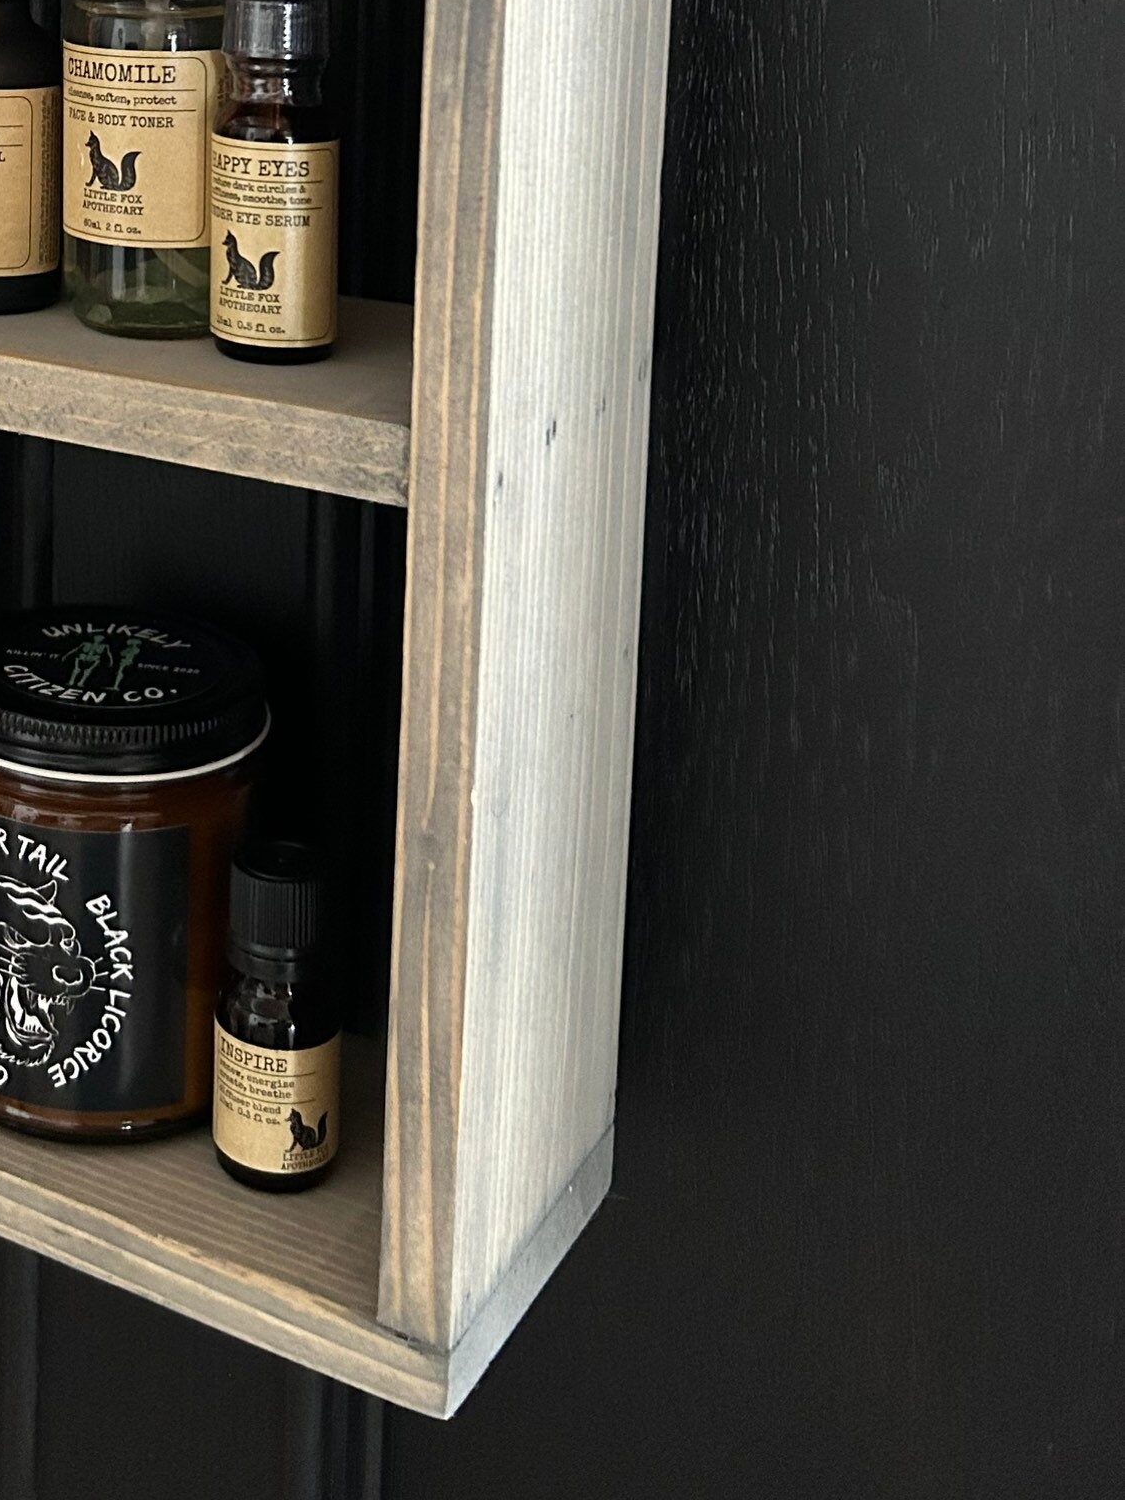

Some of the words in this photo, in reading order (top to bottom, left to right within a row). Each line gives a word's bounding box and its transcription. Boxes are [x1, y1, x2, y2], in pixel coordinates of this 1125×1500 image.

[68, 57, 176, 84] CHAMOMILE
[95, 92, 131, 105] soften,
[133, 95, 178, 106] protect
[69, 106, 86, 122] FACE
[88, 111, 95, 123] &
[97, 112, 127, 127] BODY
[129, 115, 175, 128] TONER
[258, 160, 310, 177] EYES
[83, 187, 117, 202] LITTLE
[120, 194, 143, 204] FOX
[232, 180, 255, 192] dark
[256, 185, 297, 194] circles
[299, 185, 307, 194] &
[82, 199, 145, 216] APOTHECARY
[105, 222, 112, 231] 2
[236, 211, 262, 226] EYE
[265, 214, 311, 227] SERUM
[220, 285, 255, 301] LITTLE
[258, 293, 280, 303] FOX
[219, 296, 282, 315] APOTHECARY
[236, 320, 253, 331] 0.5
[42, 622, 192, 649] UNLIKELY
[137, 662, 170, 672] SINCE
[3, 663, 107, 703] CITIZEN
[17, 834, 70, 881] TAIL
[85, 894, 134, 981] BLACK
[47, 988, 132, 1088] LICORICE
[220, 1036, 288, 1073] INSPIRE
[249, 1084, 293, 1099] breathe
[252, 1101, 282, 1115] blend
